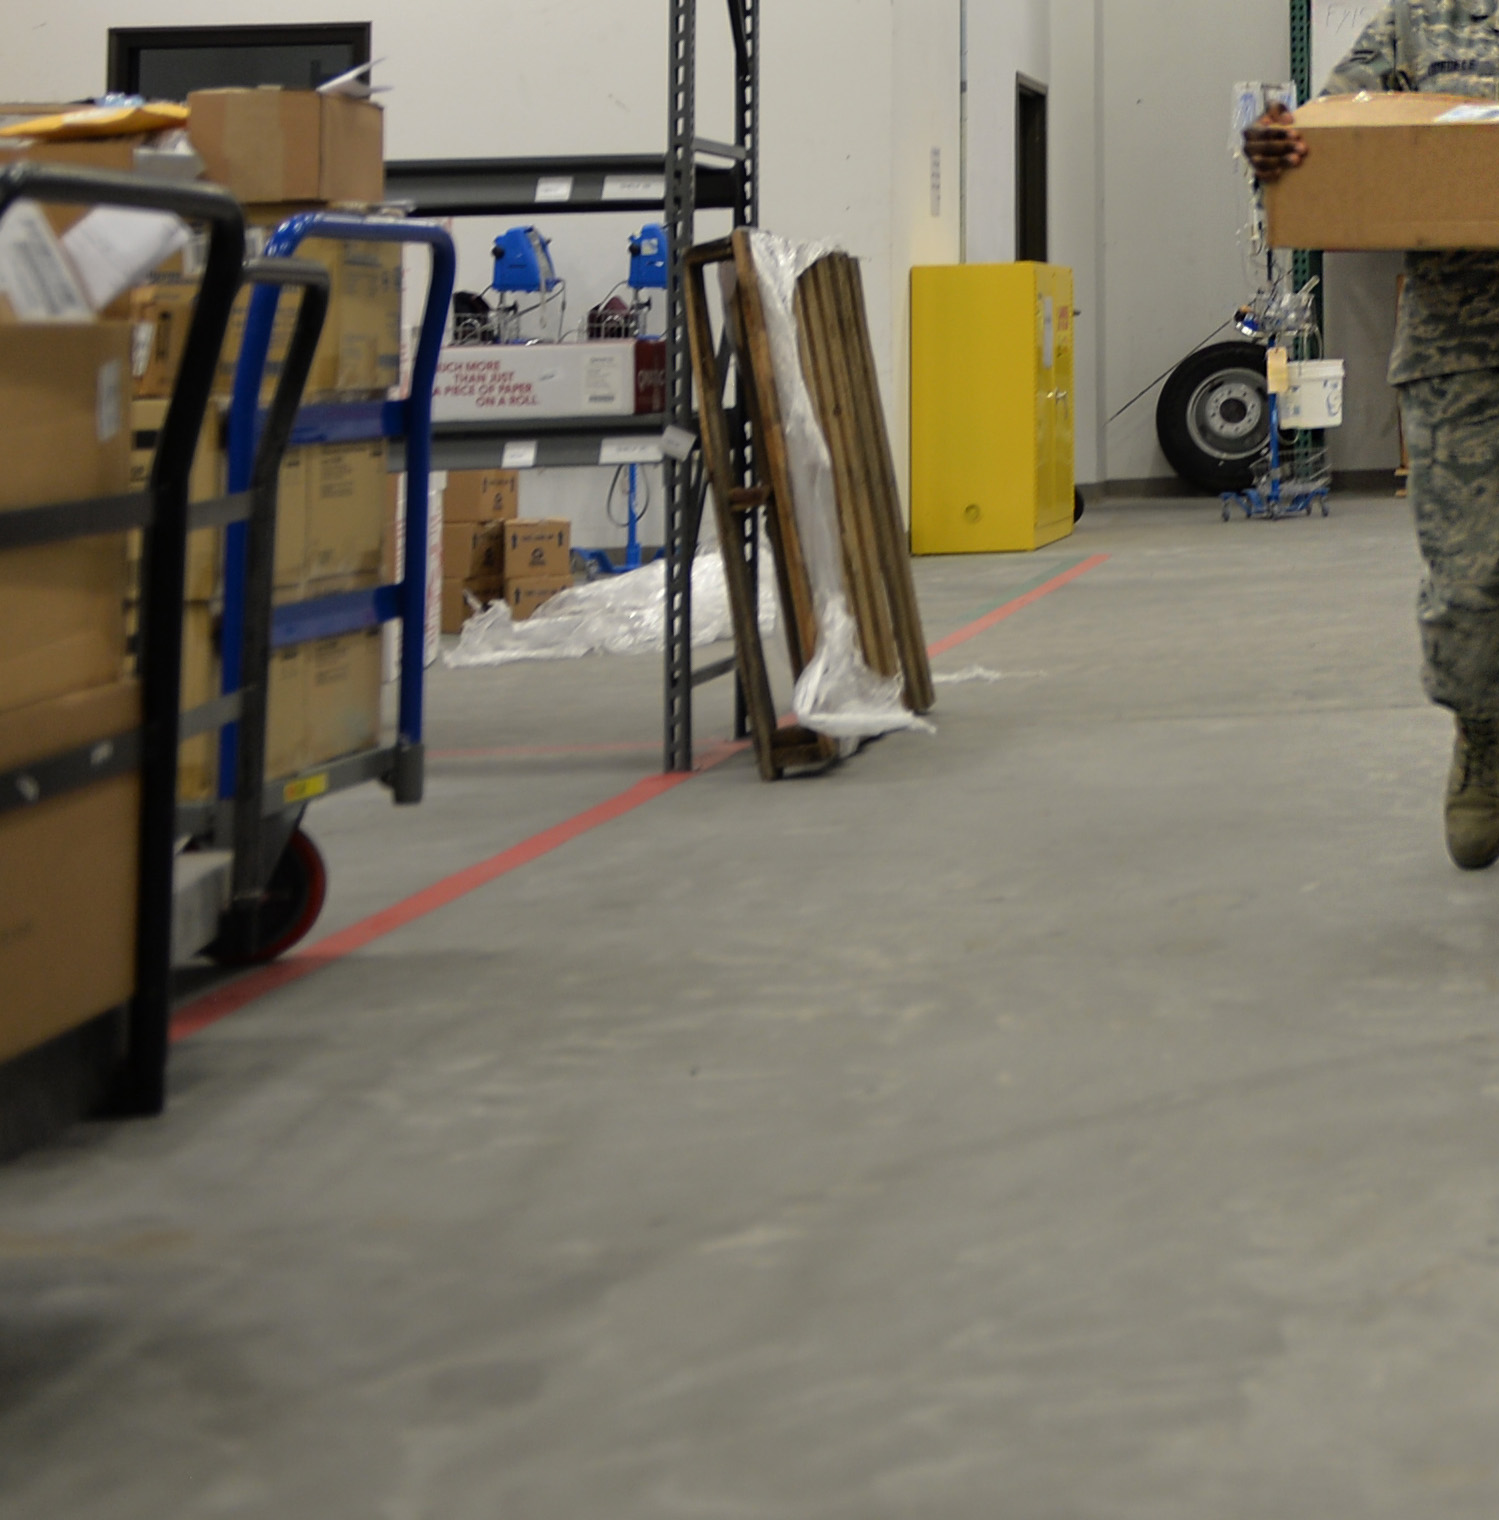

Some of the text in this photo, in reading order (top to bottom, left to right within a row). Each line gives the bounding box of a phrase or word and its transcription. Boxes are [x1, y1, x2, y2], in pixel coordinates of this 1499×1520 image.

[436, 360, 500, 373] UCH MORE
[499, 383, 533, 395] PAPER
[509, 395, 539, 406] ROLL
